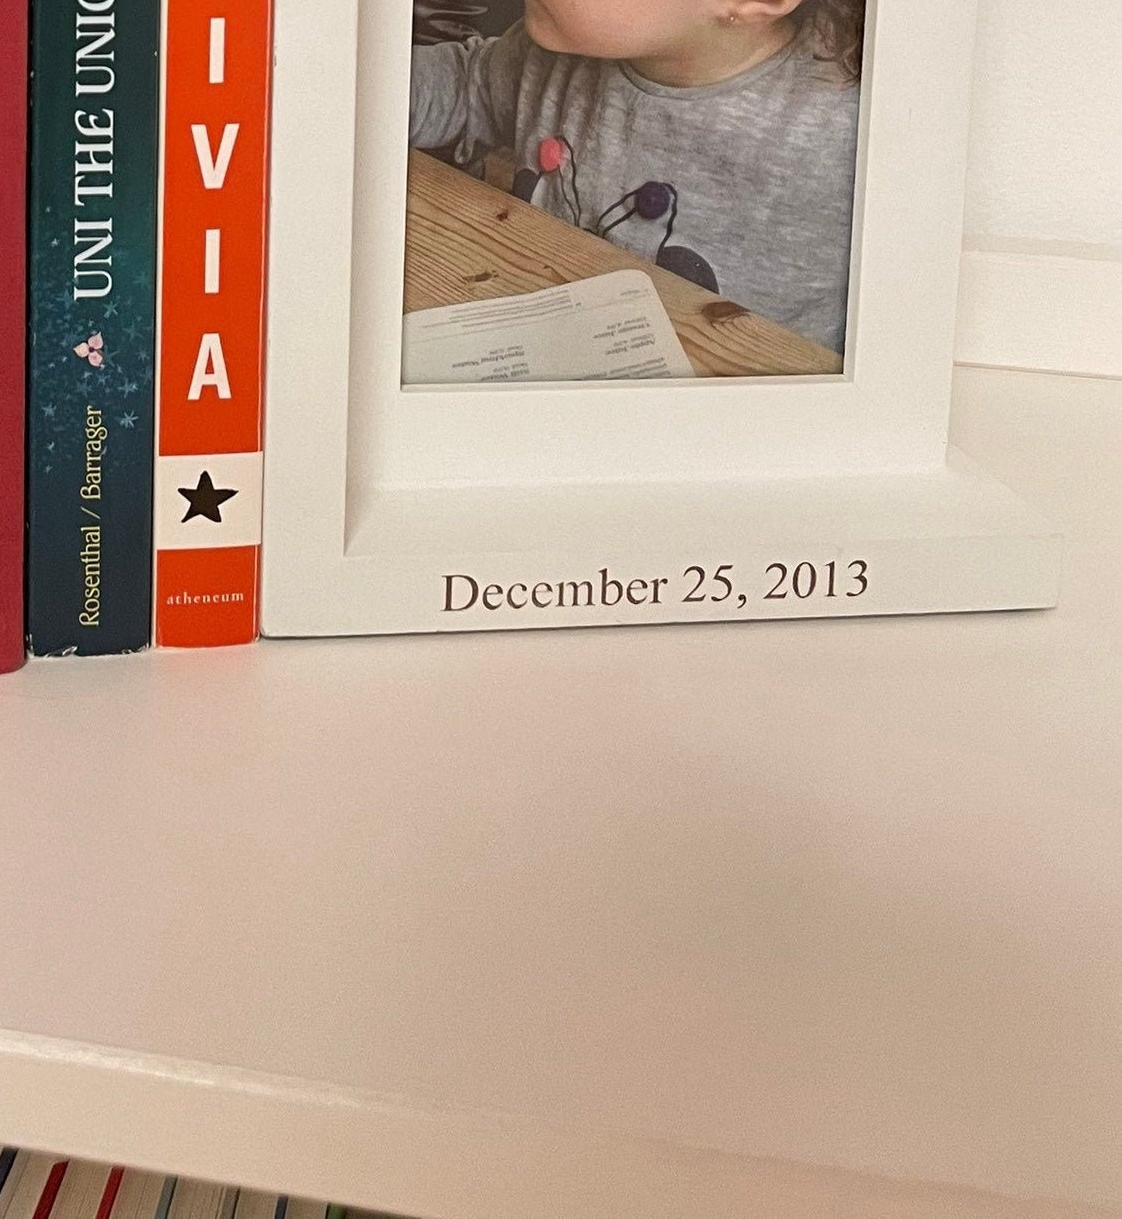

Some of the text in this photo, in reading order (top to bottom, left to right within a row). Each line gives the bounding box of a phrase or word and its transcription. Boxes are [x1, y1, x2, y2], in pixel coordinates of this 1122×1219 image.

[74, 108, 115, 206] THE
[73, 217, 114, 301] UNI
[80, 404, 108, 500] Barrager
[78, 526, 101, 627] Rosenthal
[166, 590, 245, 605] atheneum
[441, 559, 869, 612] December 25, 2013
